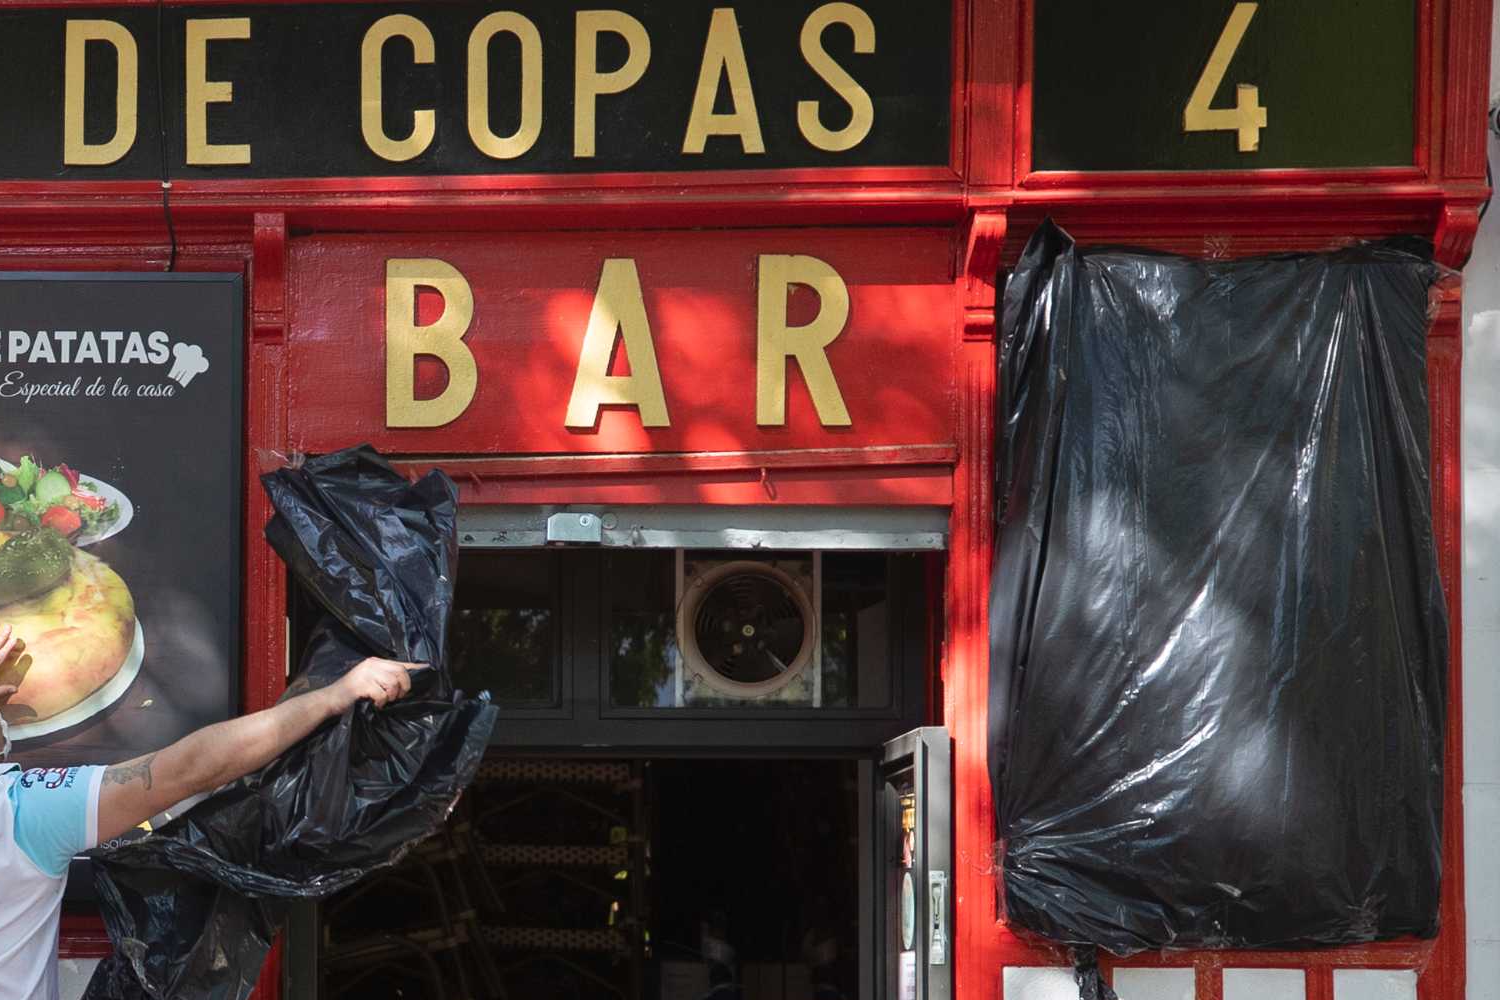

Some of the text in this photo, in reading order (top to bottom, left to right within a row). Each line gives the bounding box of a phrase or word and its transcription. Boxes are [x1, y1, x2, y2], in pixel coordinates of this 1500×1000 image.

[63, 17, 252, 167] DE
[360, 2, 876, 162] COPAS
[1183, 2, 1268, 152] 4
[8, 331, 170, 365] PATATAS
[85, 376, 107, 397] de
[111, 376, 131, 397] la
[136, 384, 175, 398] casa
[385, 254, 853, 429] BAR
